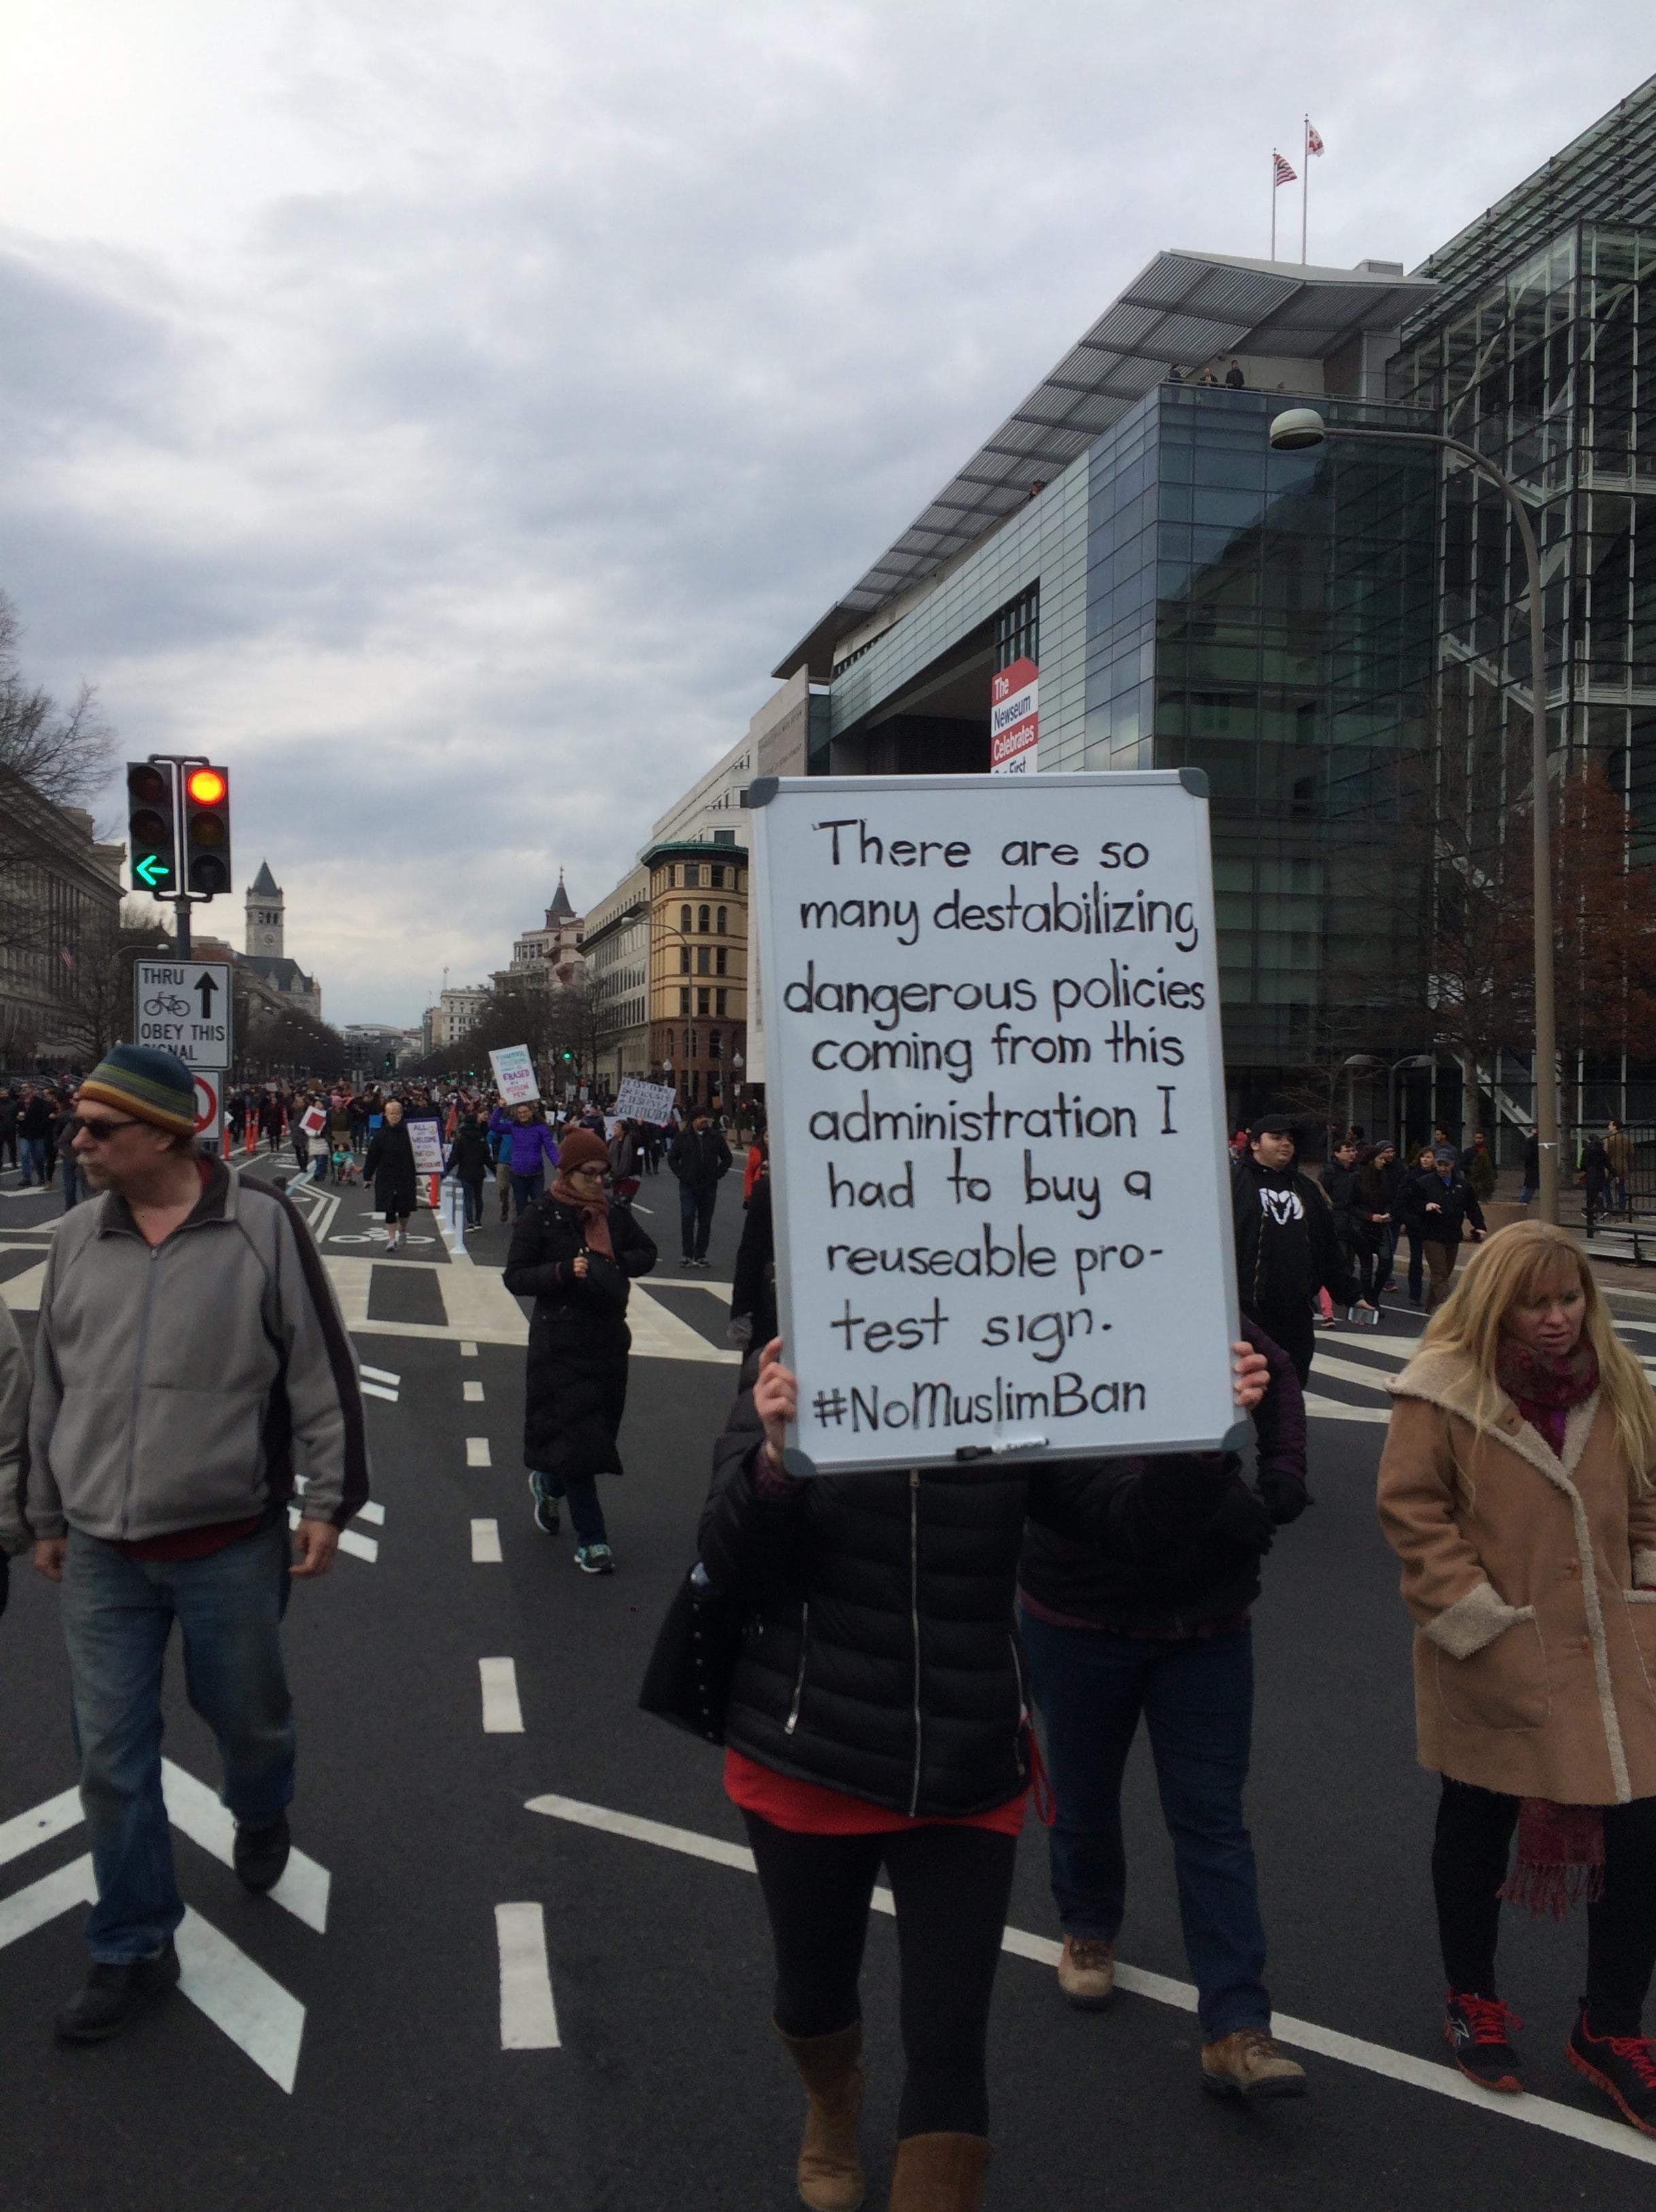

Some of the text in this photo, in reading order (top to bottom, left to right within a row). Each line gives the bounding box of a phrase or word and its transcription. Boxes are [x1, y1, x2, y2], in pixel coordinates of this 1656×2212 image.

[994, 677, 1009, 700] The
[994, 695, 1031, 731] Newseum
[993, 724, 1034, 761] Celebrates
[813, 819, 1149, 869] There are so
[801, 881, 1198, 952] many destabilizing
[141, 967, 184, 985] THRU
[784, 958, 1205, 1031] dangerous policies
[141, 1023, 225, 1041] OBEY THIS
[812, 1020, 1184, 1083] coming from this
[809, 1086, 1178, 1143] administration I
[828, 1147, 1150, 1220] had to buy a
[827, 1222, 1163, 1295] reuseable pro-
[831, 1297, 1112, 1363] test sign.
[812, 1372, 1145, 1432] #NoMuslimBan
